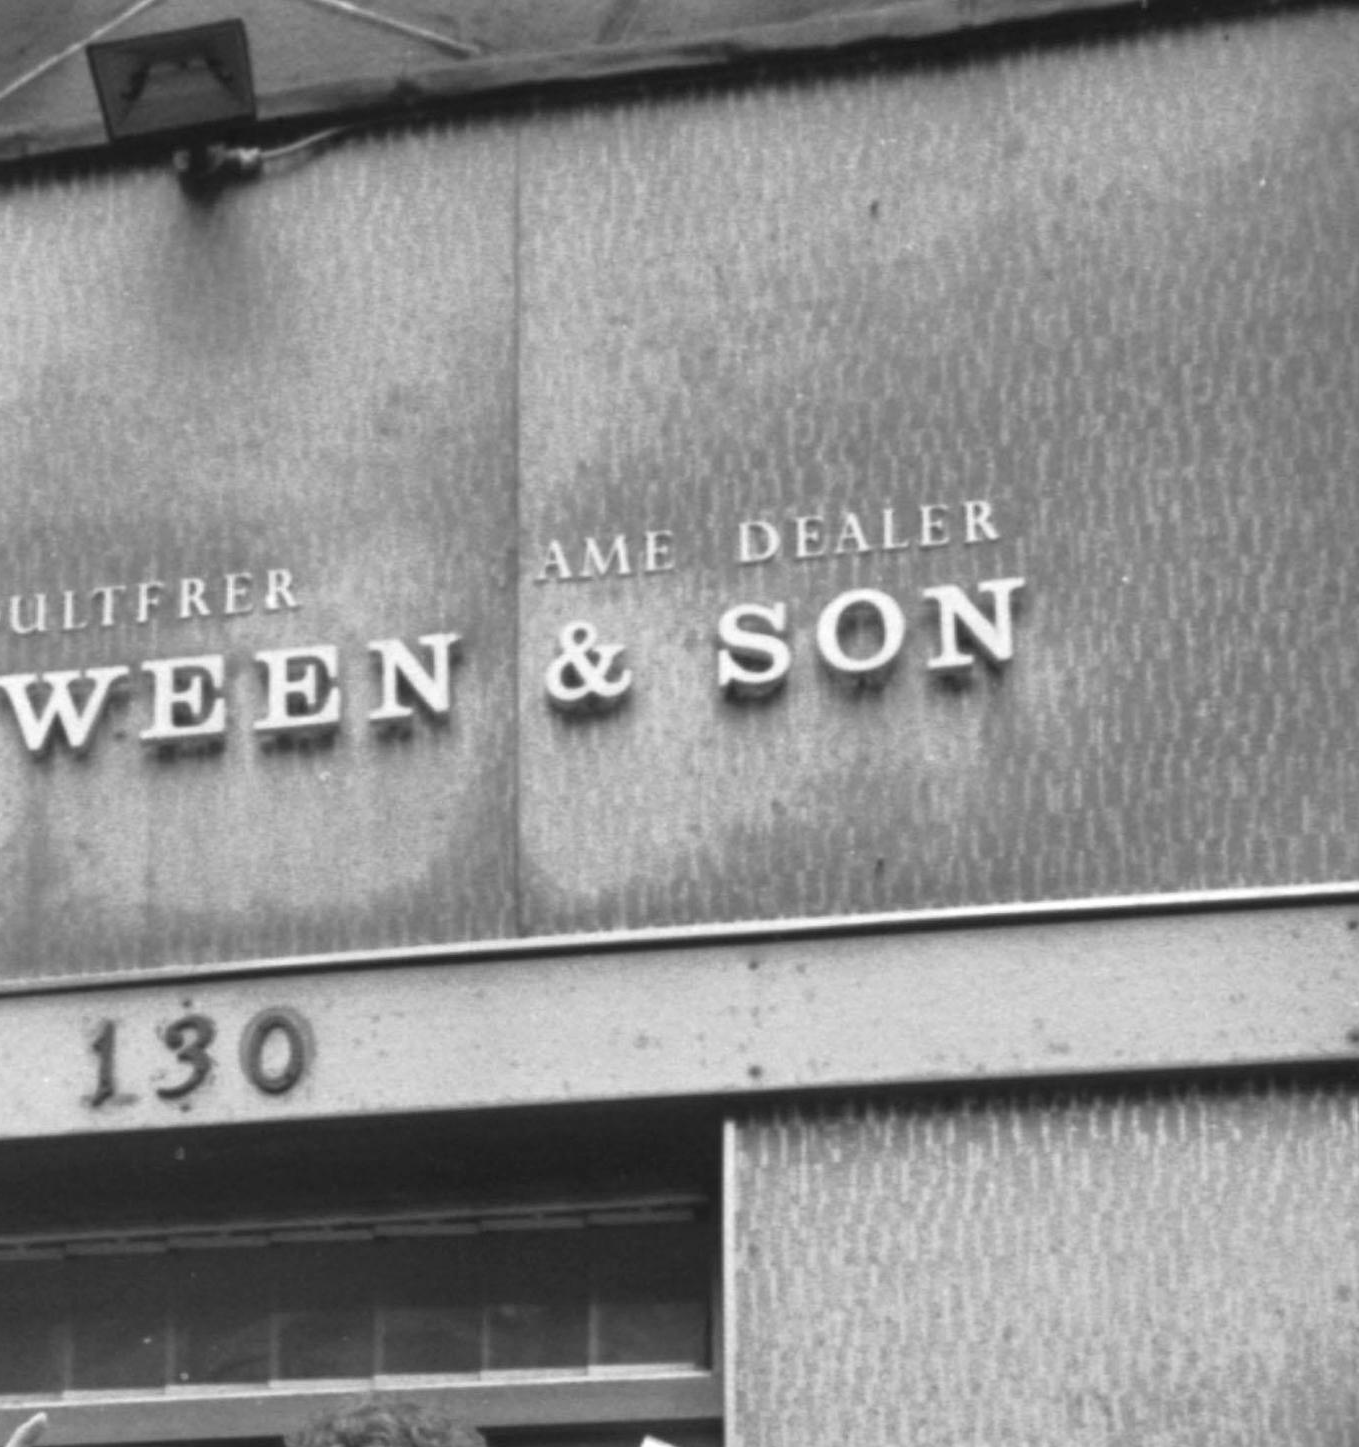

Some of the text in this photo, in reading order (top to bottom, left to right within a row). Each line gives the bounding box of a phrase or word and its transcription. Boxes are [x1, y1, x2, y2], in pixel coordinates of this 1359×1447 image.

[534, 529, 676, 582] AME
[737, 499, 1002, 563] DEALER
[545, 621, 632, 703] &
[717, 578, 1026, 689] SON
[82, 1005, 317, 1108] 130
